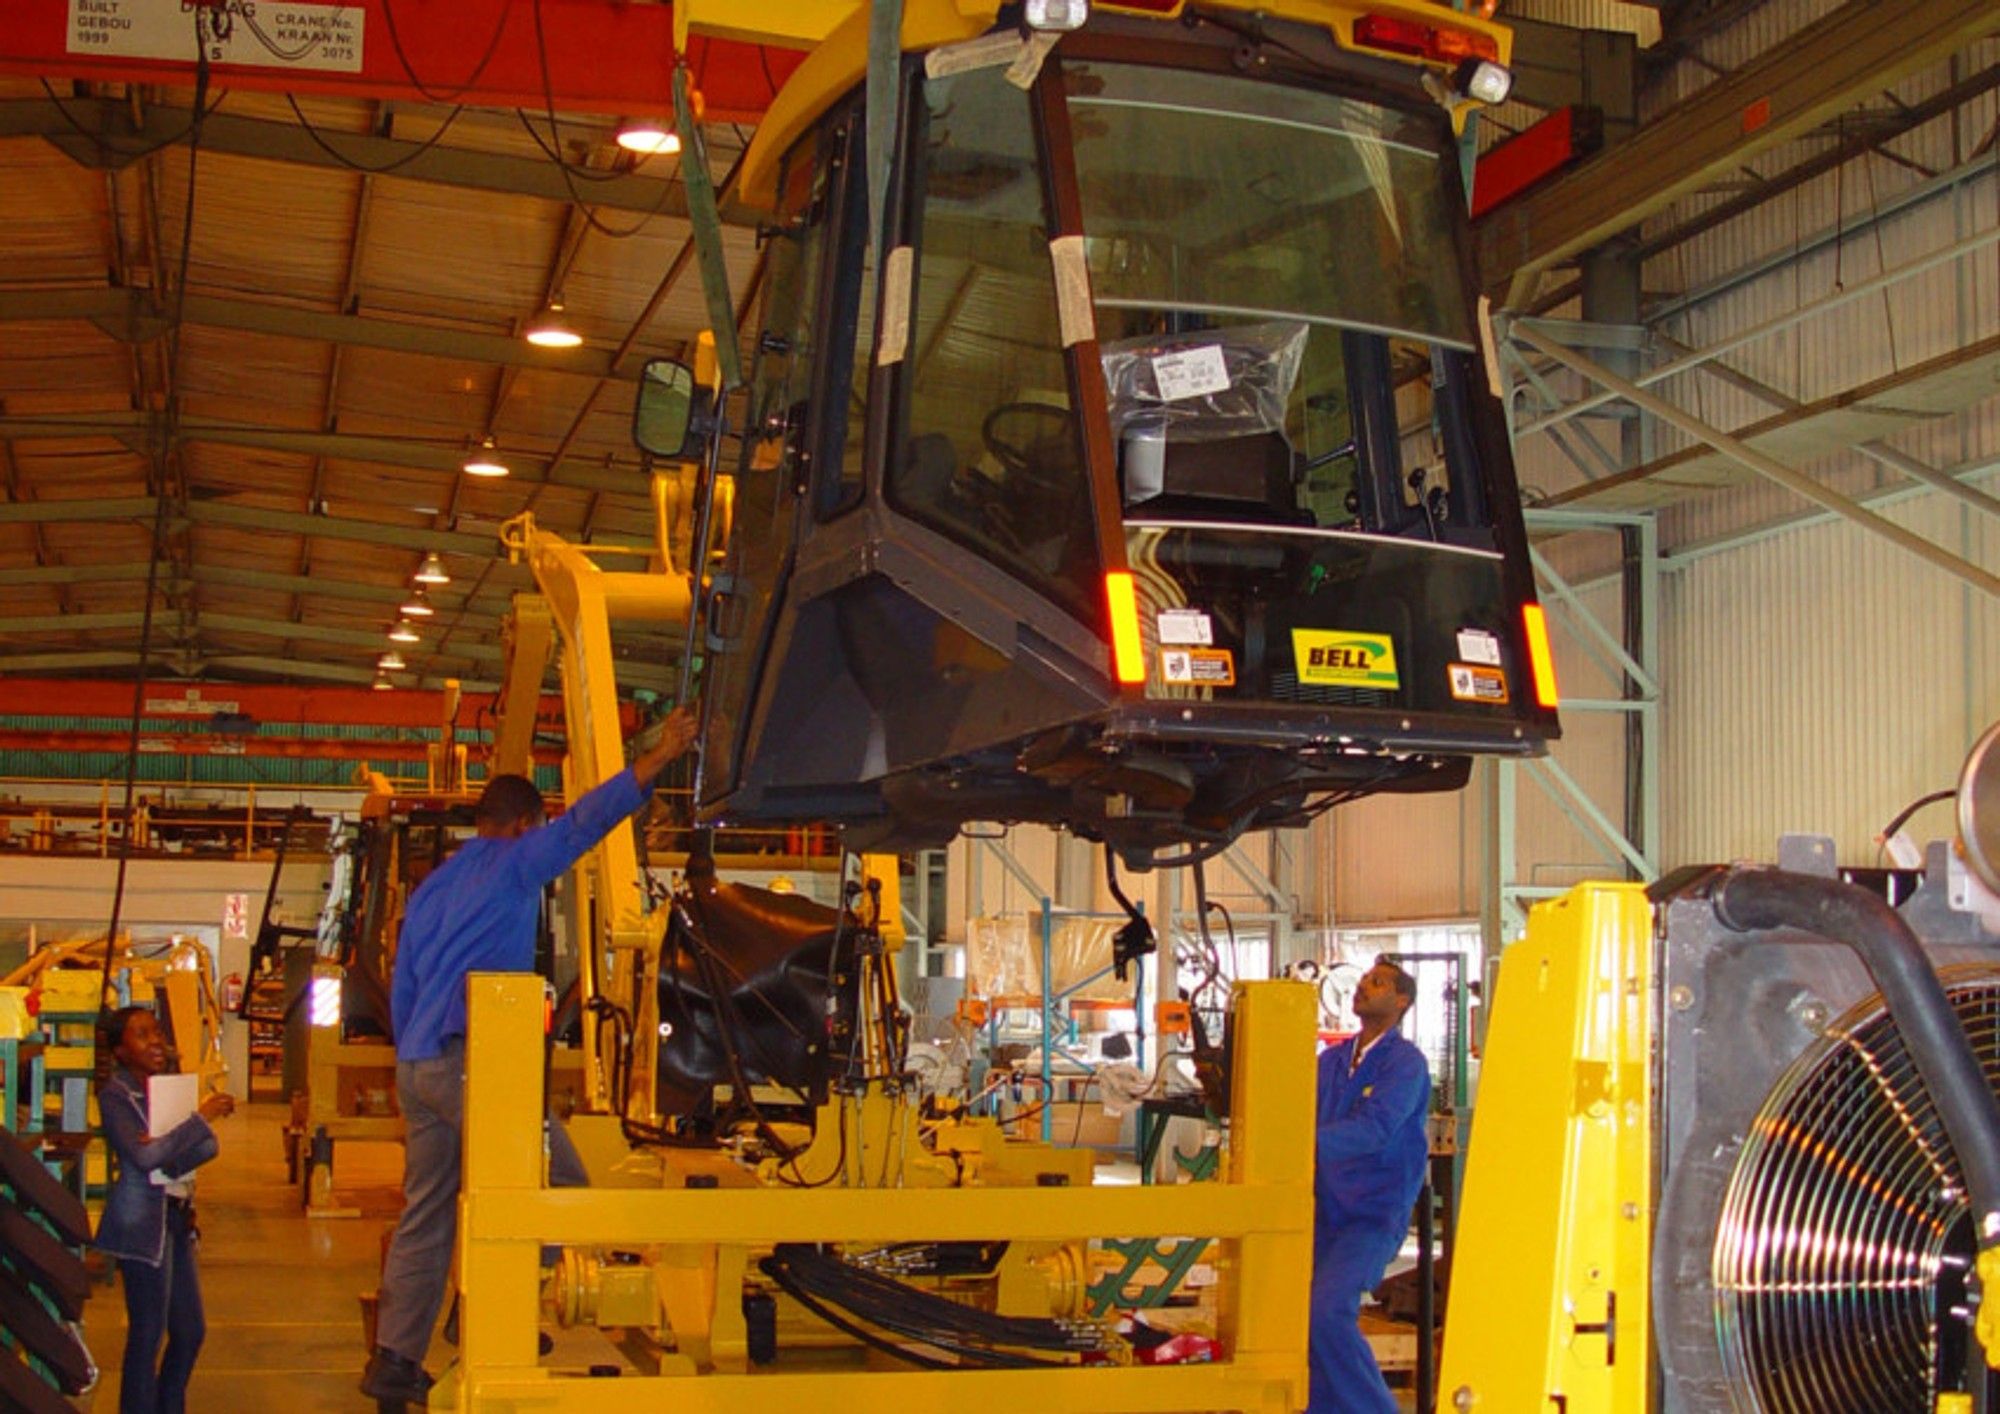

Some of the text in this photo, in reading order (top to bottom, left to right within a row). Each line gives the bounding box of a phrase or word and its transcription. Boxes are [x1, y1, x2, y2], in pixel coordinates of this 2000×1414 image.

[78, 0, 119, 13] BUILT
[181, 0, 256, 18] DAG
[77, 16, 131, 30] GEBOU
[274, 13, 327, 29] CRANE
[77, 32, 110, 43] 1999
[277, 29, 332, 43] KRAAN
[1309, 647, 1370, 669] BELL
